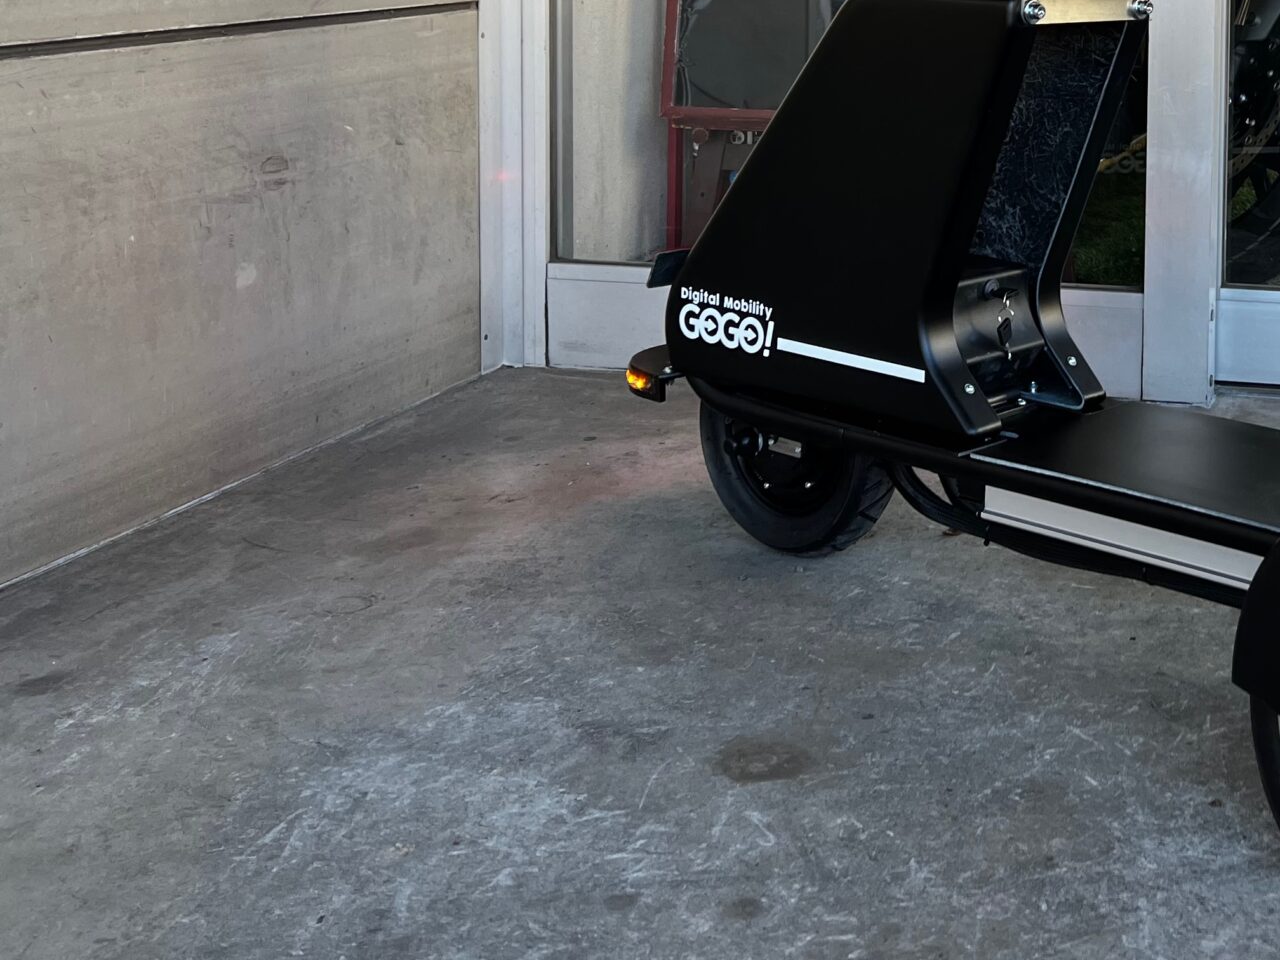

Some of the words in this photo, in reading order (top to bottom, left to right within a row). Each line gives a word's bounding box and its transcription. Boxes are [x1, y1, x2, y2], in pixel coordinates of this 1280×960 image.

[680, 286, 720, 306] Digital
[723, 295, 773, 321] Mobility
[678, 303, 775, 358] GOGO!
